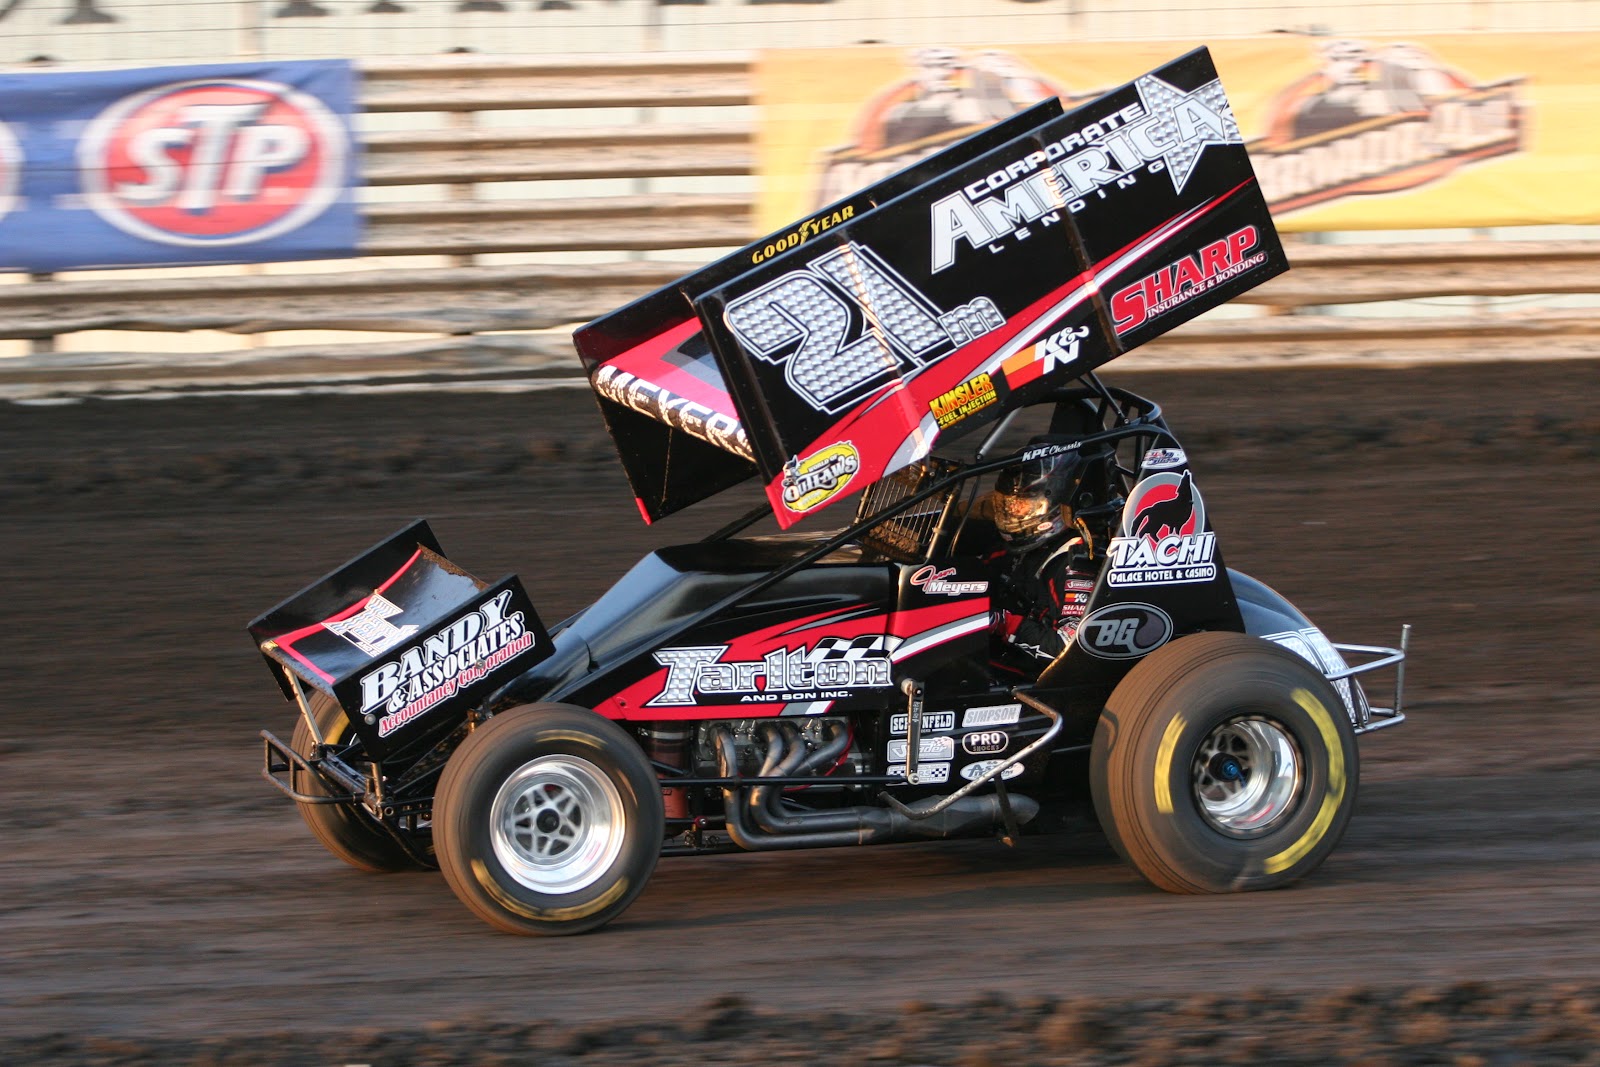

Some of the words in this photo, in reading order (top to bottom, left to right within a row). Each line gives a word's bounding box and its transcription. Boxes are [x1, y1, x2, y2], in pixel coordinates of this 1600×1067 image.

[107, 103, 313, 216] STP
[964, 101, 1148, 201] CORPORATE
[931, 95, 1227, 275] AMERICA
[988, 160, 1166, 254] LENDING
[751, 205, 855, 265] GOODYEAR
[1110, 225, 1258, 335] SHARP
[1146, 284, 1206, 319] INSURANCE
[1206, 279, 1215, 291] &
[1214, 252, 1265, 285] BONDING
[1034, 325, 1090, 375] K&N
[929, 373, 994, 420] KINSLER
[938, 412, 958, 425] FUEL
[958, 390, 997, 415] INJECTION
[784, 455, 858, 502] OUTLAWS
[1107, 532, 1216, 570] TACHI
[1111, 572, 1143, 584] PALACE
[1145, 570, 1174, 582] HOTEL
[1175, 570, 1184, 580] &
[1185, 567, 1214, 579] CASINO
[928, 581, 988, 595] Meyers
[361, 590, 513, 714] BANDY
[1095, 618, 1140, 650] BG
[386, 686, 410, 714] &
[408, 612, 524, 704] ASSOCIATES
[646, 645, 893, 706] Tarlton
[379, 678, 457, 738] Accountancy
[741, 693, 778, 703] AND
[782, 692, 818, 701] SON
[820, 690, 853, 700] INC.
[965, 707, 1017, 724] SIMPSON
[970, 732, 1001, 746] PRO
